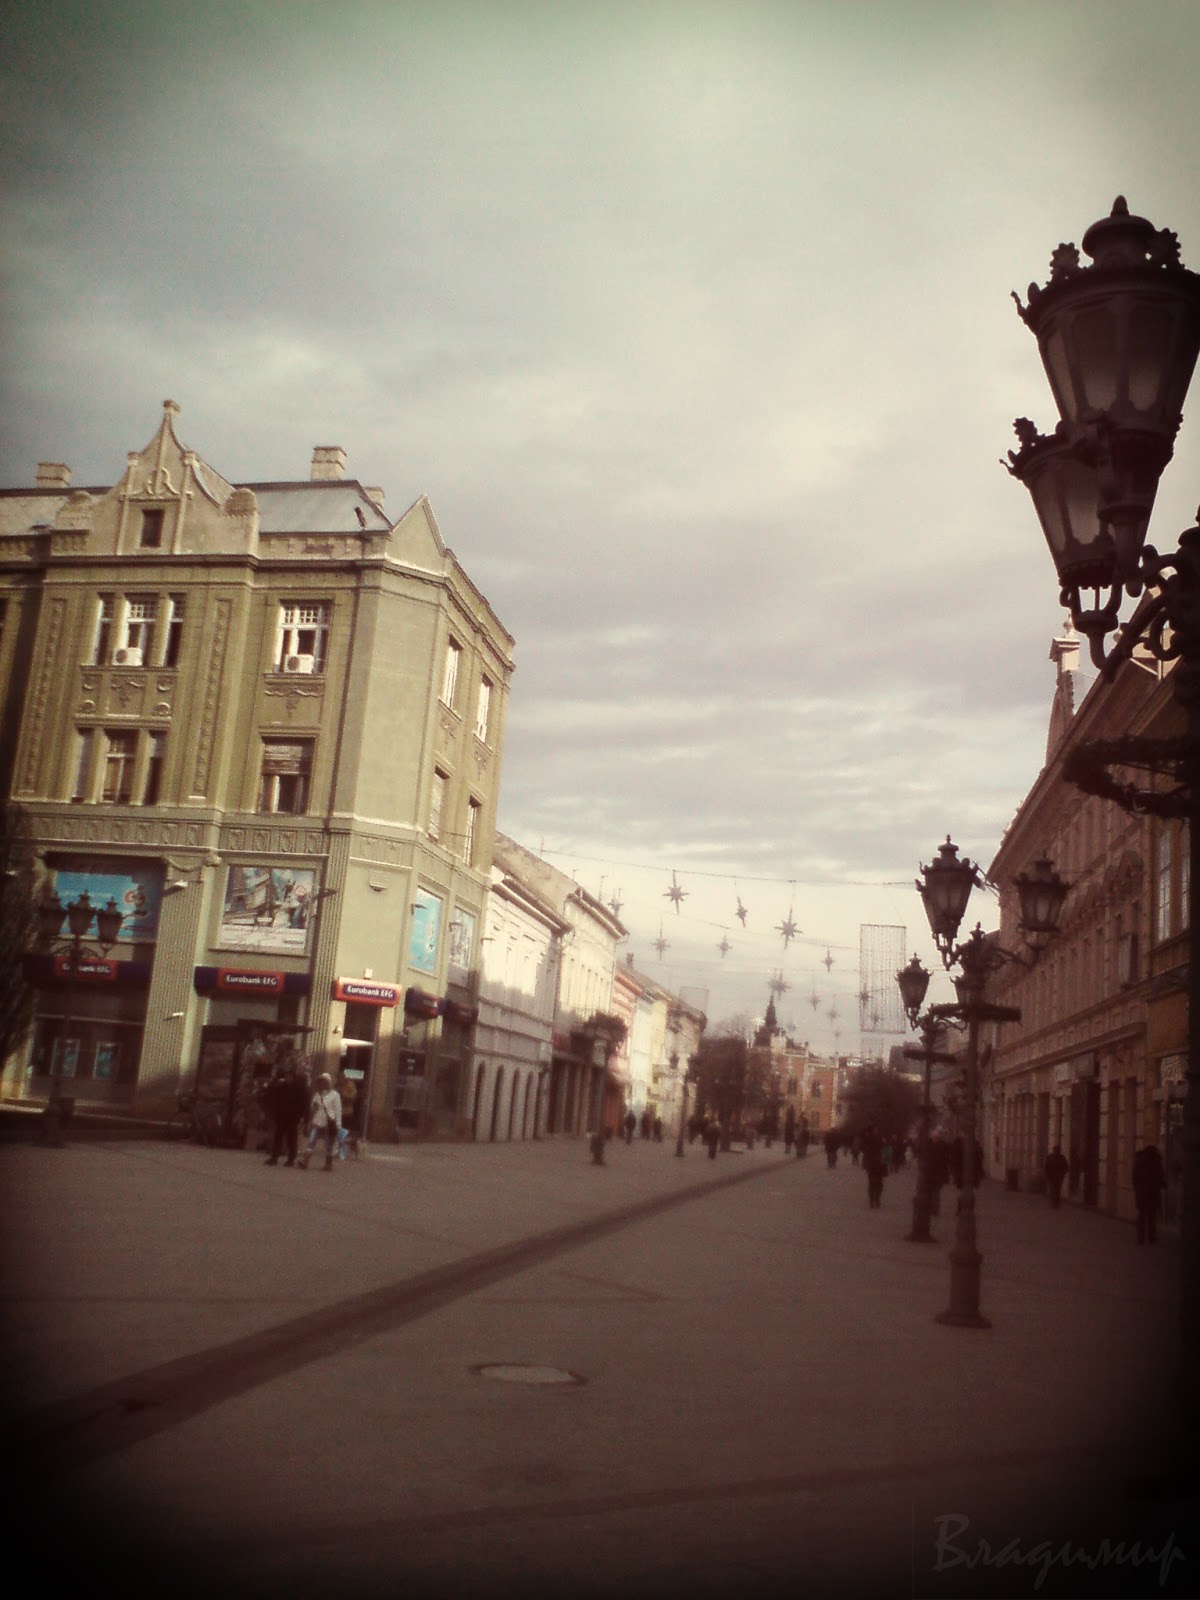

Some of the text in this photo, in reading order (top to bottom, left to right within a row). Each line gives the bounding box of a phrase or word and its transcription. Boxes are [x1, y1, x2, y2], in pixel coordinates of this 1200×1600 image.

[226, 974, 277, 986] Eurobank EFG
[347, 985, 394, 998] Eurobank EFG
